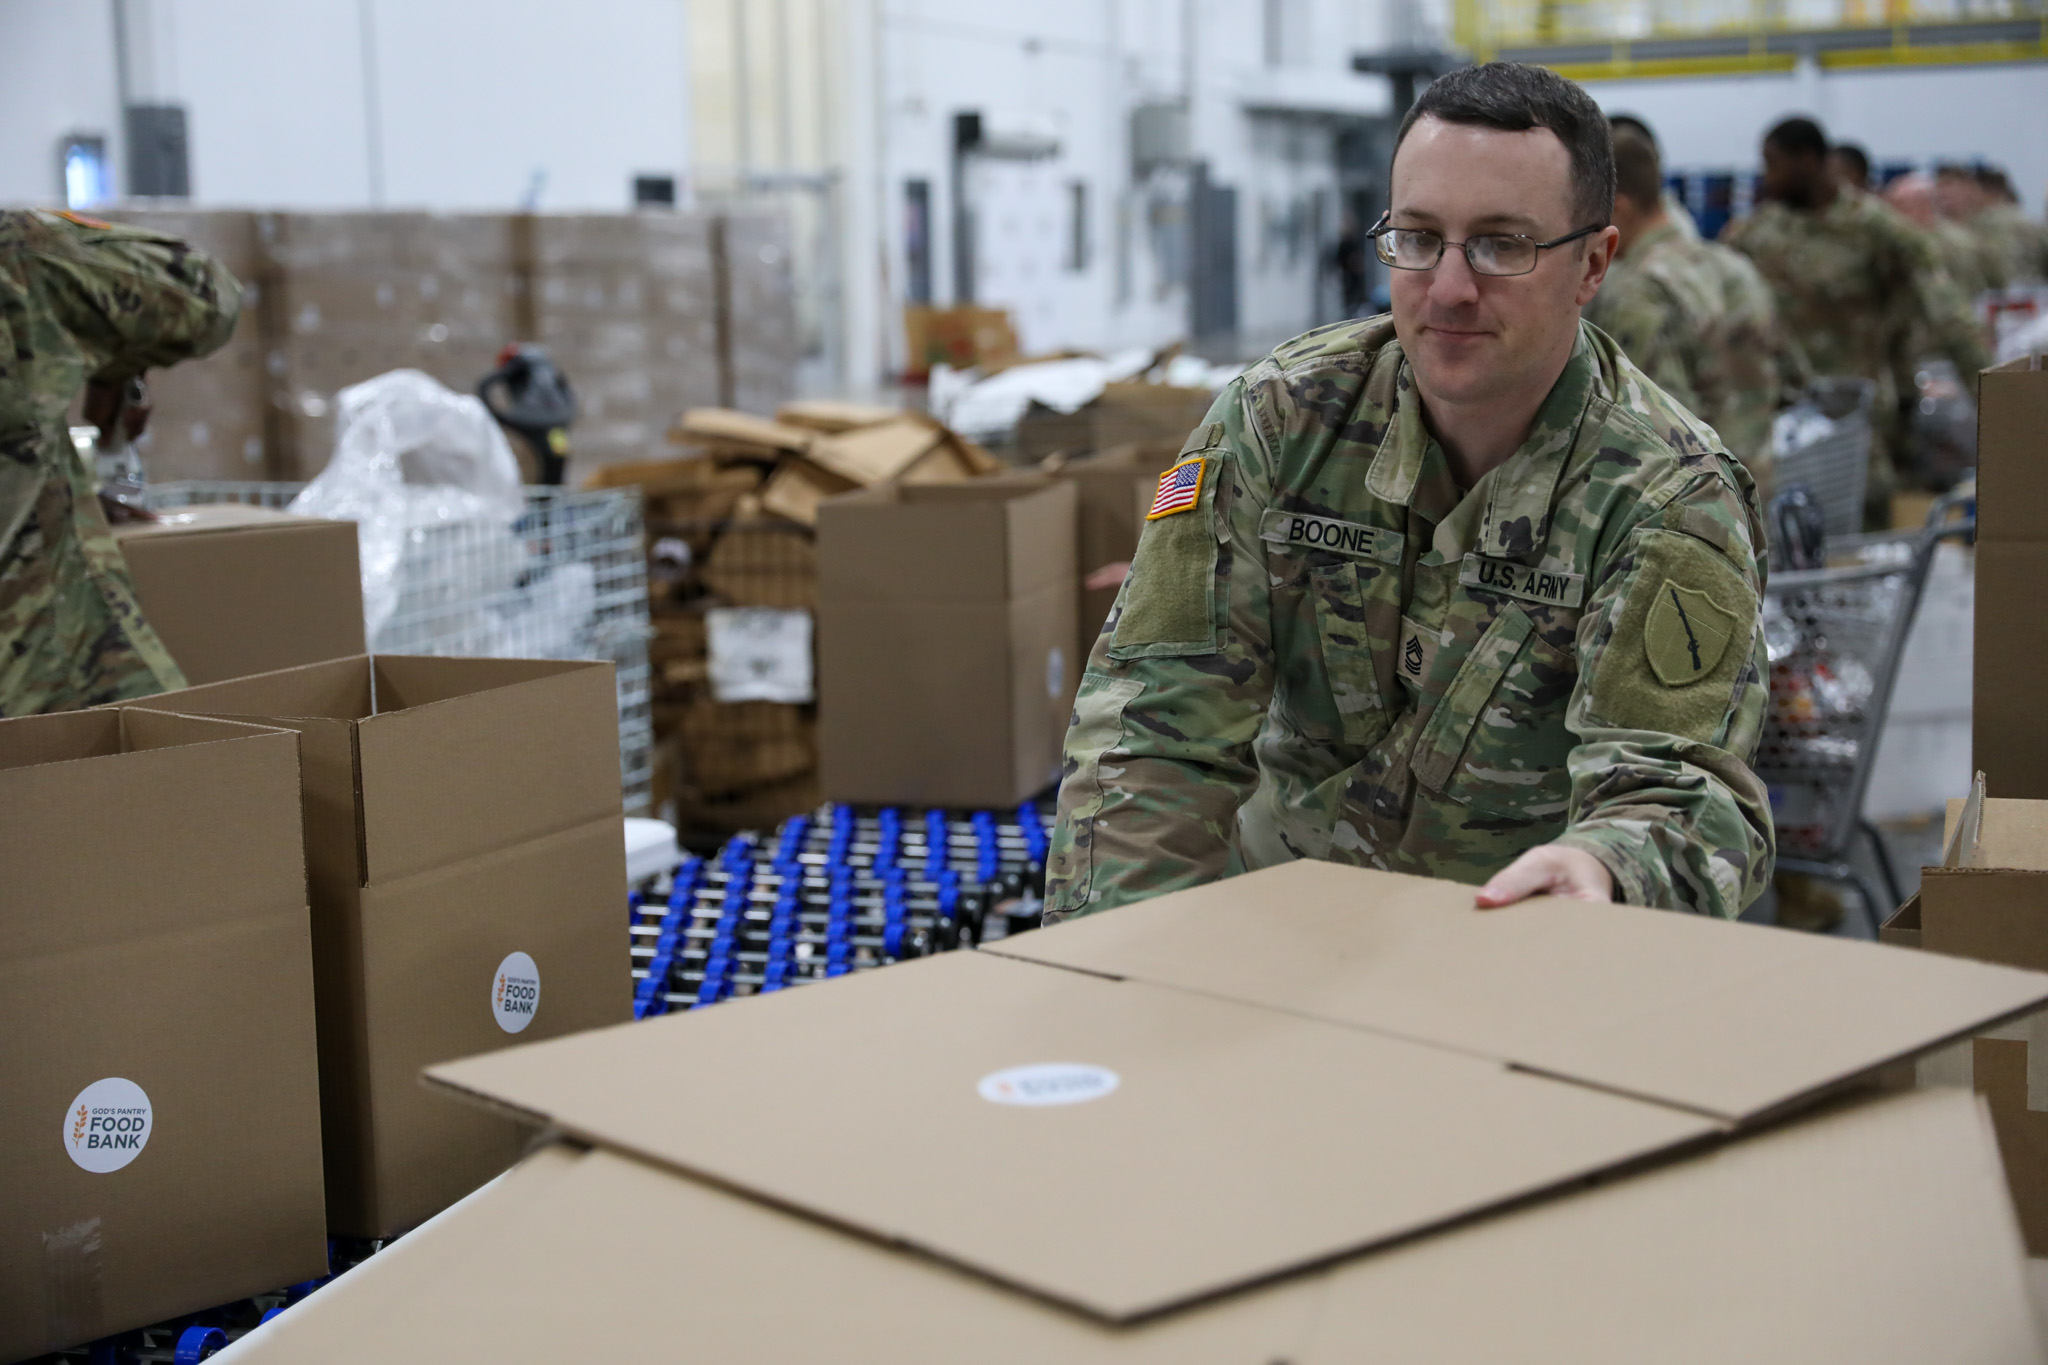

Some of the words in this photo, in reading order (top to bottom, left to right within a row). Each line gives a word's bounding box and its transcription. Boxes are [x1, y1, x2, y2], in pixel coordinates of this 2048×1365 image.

[1289, 518, 1374, 553] BOONE
[1478, 561, 1517, 590] U.S.
[1523, 573, 1570, 600] ARMY
[506, 985, 536, 1000] FOOD
[504, 999, 533, 1014] BANK
[90, 1117, 144, 1132] FOOD
[88, 1134, 141, 1149] BANK
